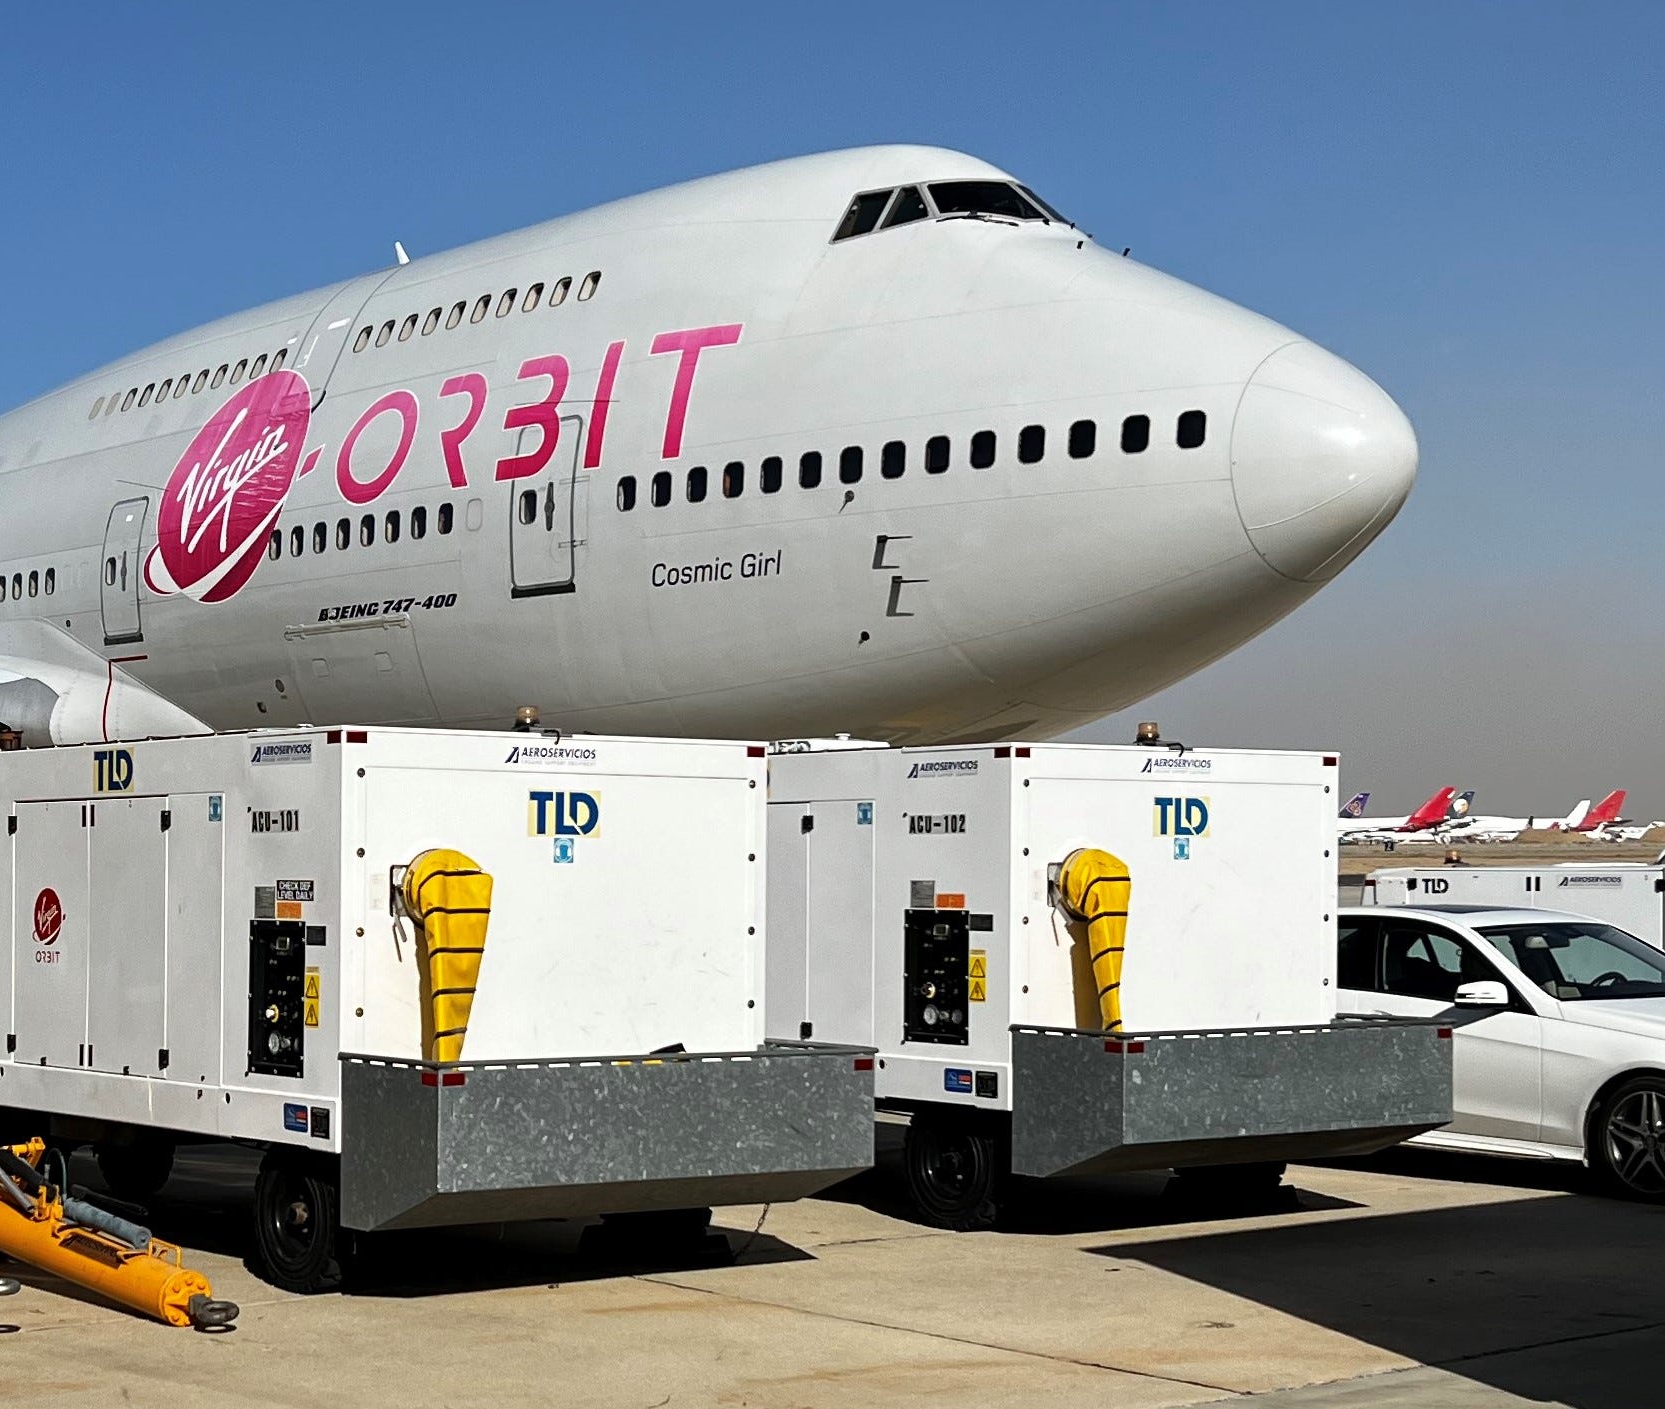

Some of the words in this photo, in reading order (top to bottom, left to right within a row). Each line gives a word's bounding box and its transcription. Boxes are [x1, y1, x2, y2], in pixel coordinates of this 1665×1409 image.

[335, 322, 744, 506] ORBIT
[176, 407, 289, 554] Virgin
[651, 556, 733, 587] Cosmic
[740, 549, 782, 578] Girl
[382, 593, 458, 614] 747-400
[521, 746, 597, 760] AEROSERVICIOS
[1153, 758, 1212, 769] AEROSERVICIOS
[93, 749, 134, 792] TLD
[919, 760, 978, 772] AEROSERVICIOS
[251, 809, 300, 833] ACU-101
[529, 791, 599, 835] TLD
[1154, 797, 1209, 836] TLD
[909, 814, 966, 834] ACU-102
[277, 891, 295, 900] LEVEL
[295, 891, 313, 900] DAILY
[1422, 878, 1449, 894] TLD
[35, 951, 61, 964] ORBIT
